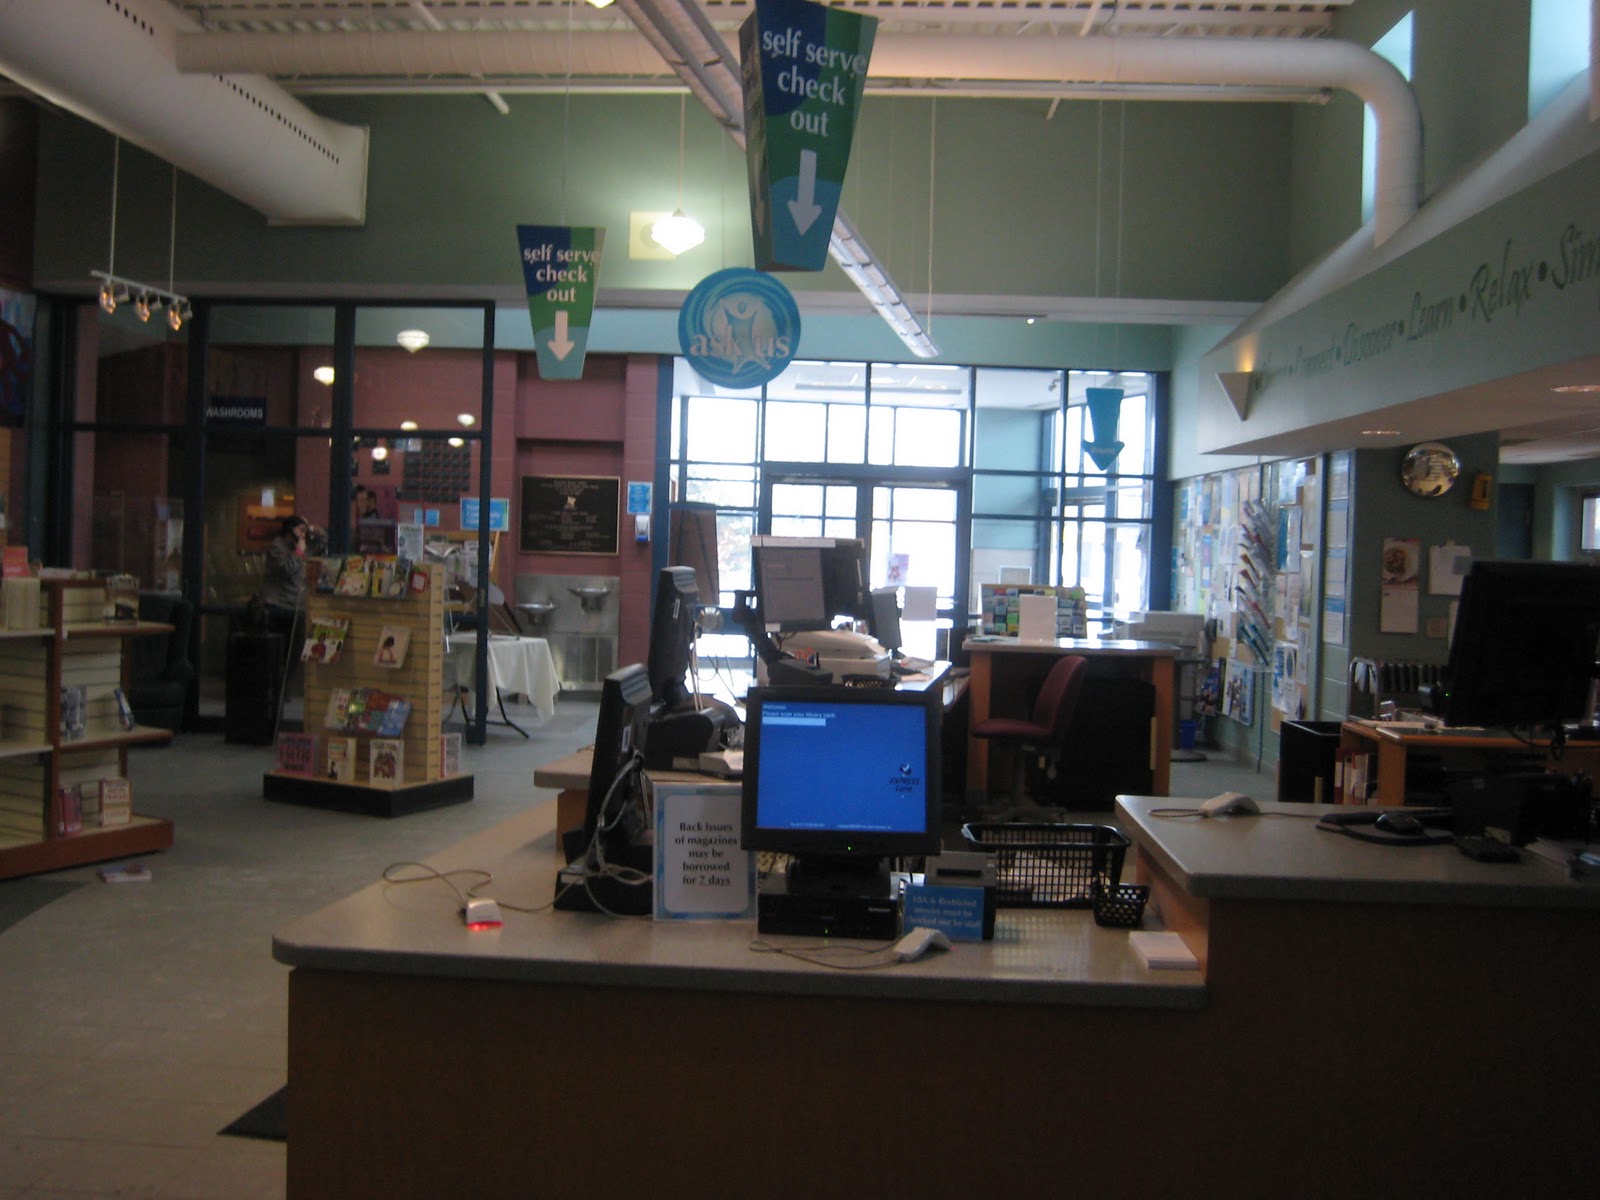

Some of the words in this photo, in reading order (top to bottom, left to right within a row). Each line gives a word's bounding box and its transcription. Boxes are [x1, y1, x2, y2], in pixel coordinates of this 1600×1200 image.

[762, 27, 802, 58] self
[805, 43, 867, 75] serve
[777, 65, 846, 105] check
[790, 110, 830, 137] out
[523, 243, 553, 262] self
[556, 249, 601, 263] serve
[536, 263, 588, 282] check
[1469, 238, 1535, 323] Relax
[546, 286, 577, 302] out
[690, 324, 740, 358] ask
[755, 336, 790, 358] us
[206, 407, 263, 419] WASHROOMS
[680, 822, 703, 831] Back
[705, 822, 733, 831] issues
[675, 835, 685, 845] of
[687, 834, 738, 847] magazines
[688, 850, 708, 859] may
[711, 848, 724, 857] be
[682, 861, 730, 871] borrowed
[683, 875, 696, 885] for
[708, 875, 730, 887] days
